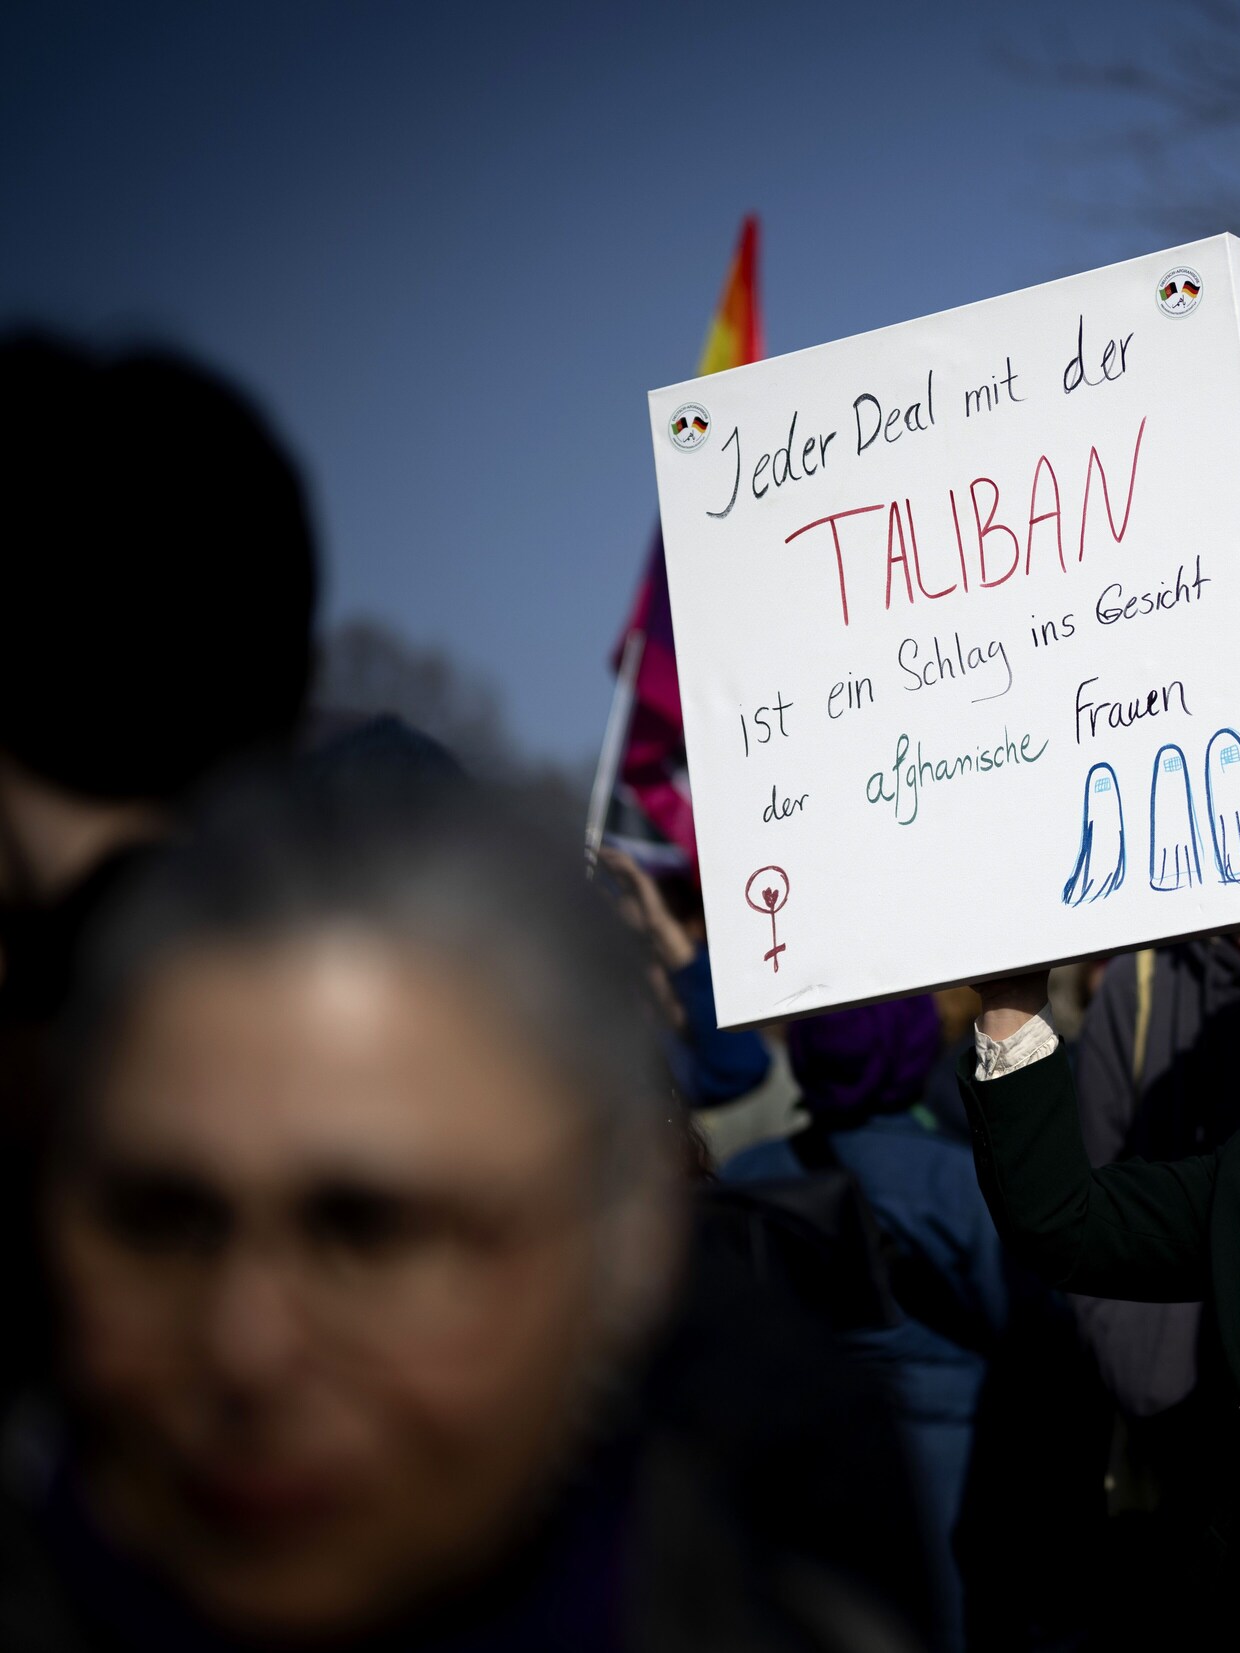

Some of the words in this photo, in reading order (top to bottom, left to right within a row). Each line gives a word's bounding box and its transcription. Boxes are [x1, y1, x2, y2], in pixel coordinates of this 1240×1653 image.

[707, 411, 837, 519] Jeder
[854, 369, 935, 457] Deal
[964, 357, 1024, 418] mit
[1064, 315, 1134, 394] der
[785, 416, 1147, 626] TALIBAN
[739, 691, 794, 757] ist
[828, 671, 873, 720] ein
[898, 631, 1012, 703] Schlag
[1030, 612, 1075, 648] ins
[1095, 555, 1211, 626] Gesicht
[762, 785, 809, 824] der
[867, 727, 1049, 825] afghanische
[1076, 676, 1193, 745] Frauen
